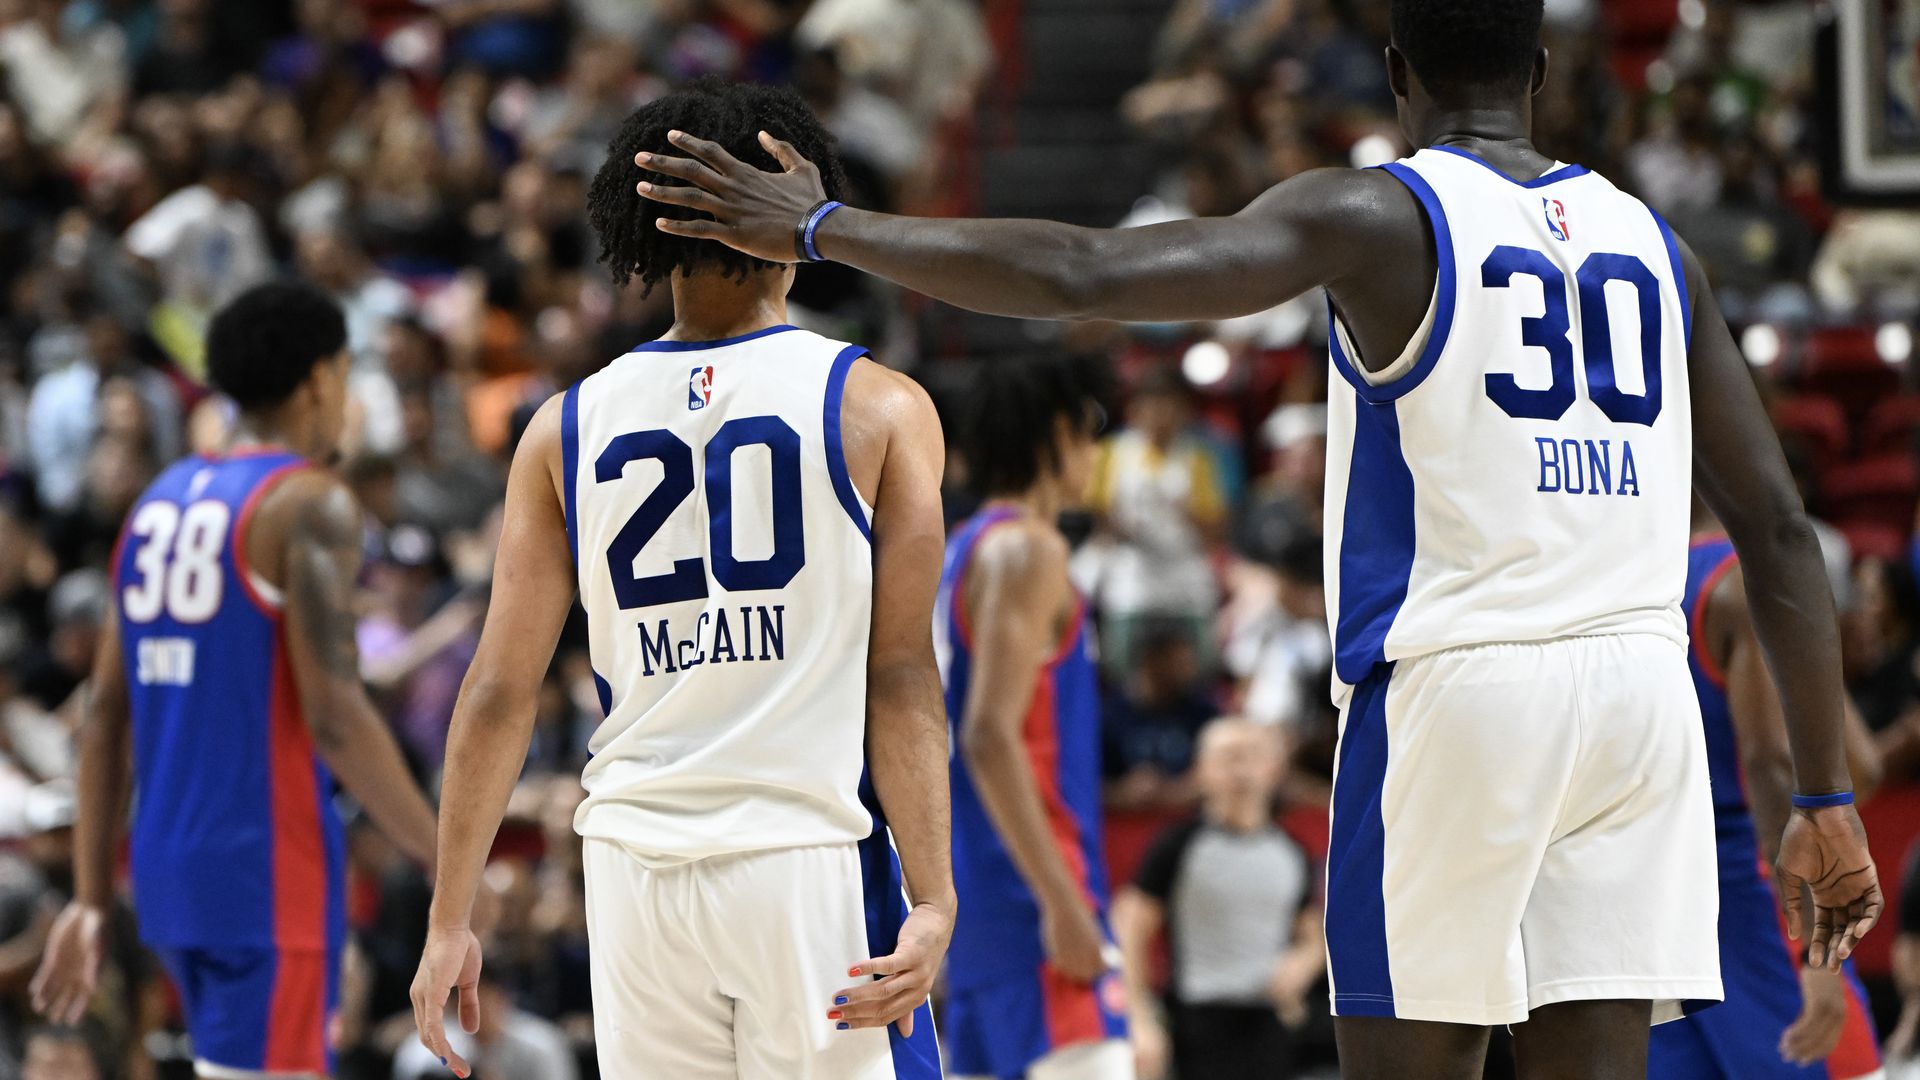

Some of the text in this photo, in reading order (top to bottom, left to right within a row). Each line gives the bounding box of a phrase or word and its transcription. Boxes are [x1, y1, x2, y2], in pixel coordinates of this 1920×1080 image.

[1481, 245, 1662, 428] 30
[690, 400, 703, 409] NBA
[594, 415, 806, 610] 20
[1535, 437, 1640, 496] BONA
[123, 499, 231, 623] 38
[637, 605, 785, 677] McCAIN
